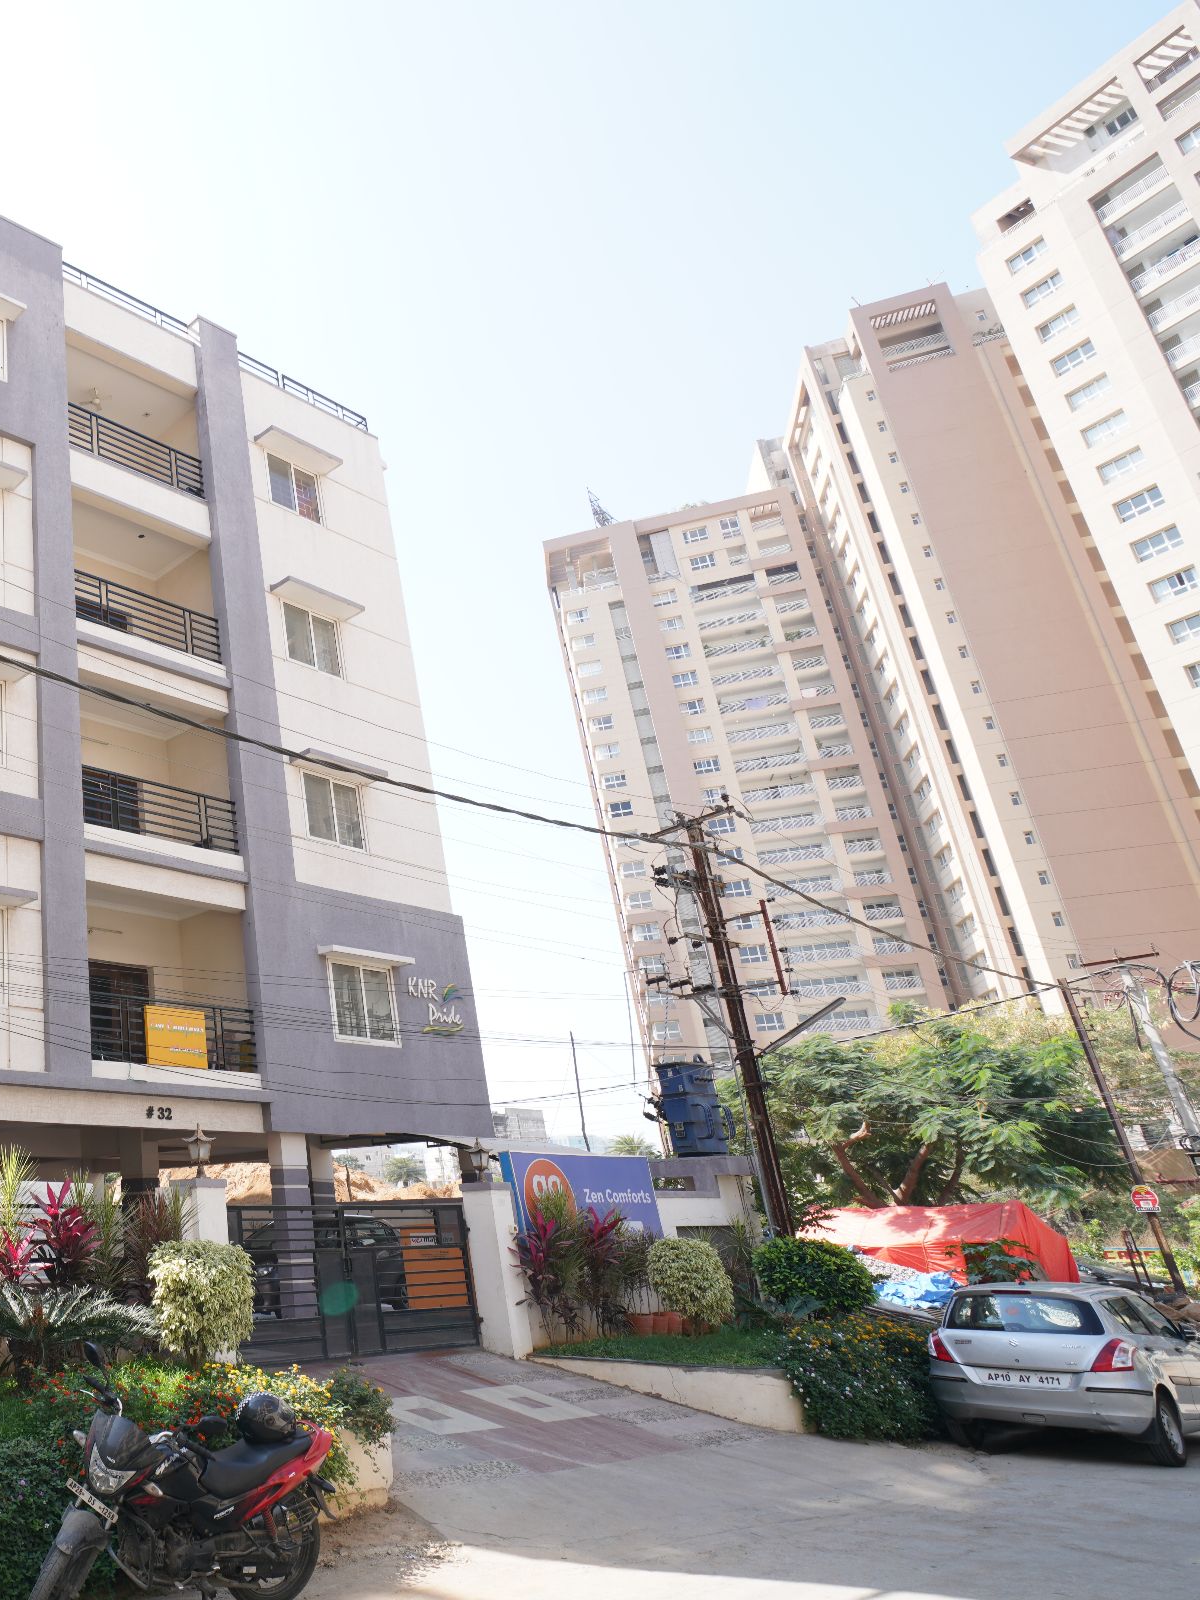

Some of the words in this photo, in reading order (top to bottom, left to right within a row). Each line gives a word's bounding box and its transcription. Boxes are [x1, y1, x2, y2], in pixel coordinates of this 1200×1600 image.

[408, 976, 439, 1001] KNR
[428, 1002, 463, 1025] Pride
[157, 1106, 173, 1121] 32
[583, 1188, 604, 1203] Zen
[605, 1188, 652, 1204] Comforts
[987, 1372, 1011, 1382] AP10
[1019, 1374, 1031, 1383] AY
[1038, 1376, 1061, 1385] 4171
